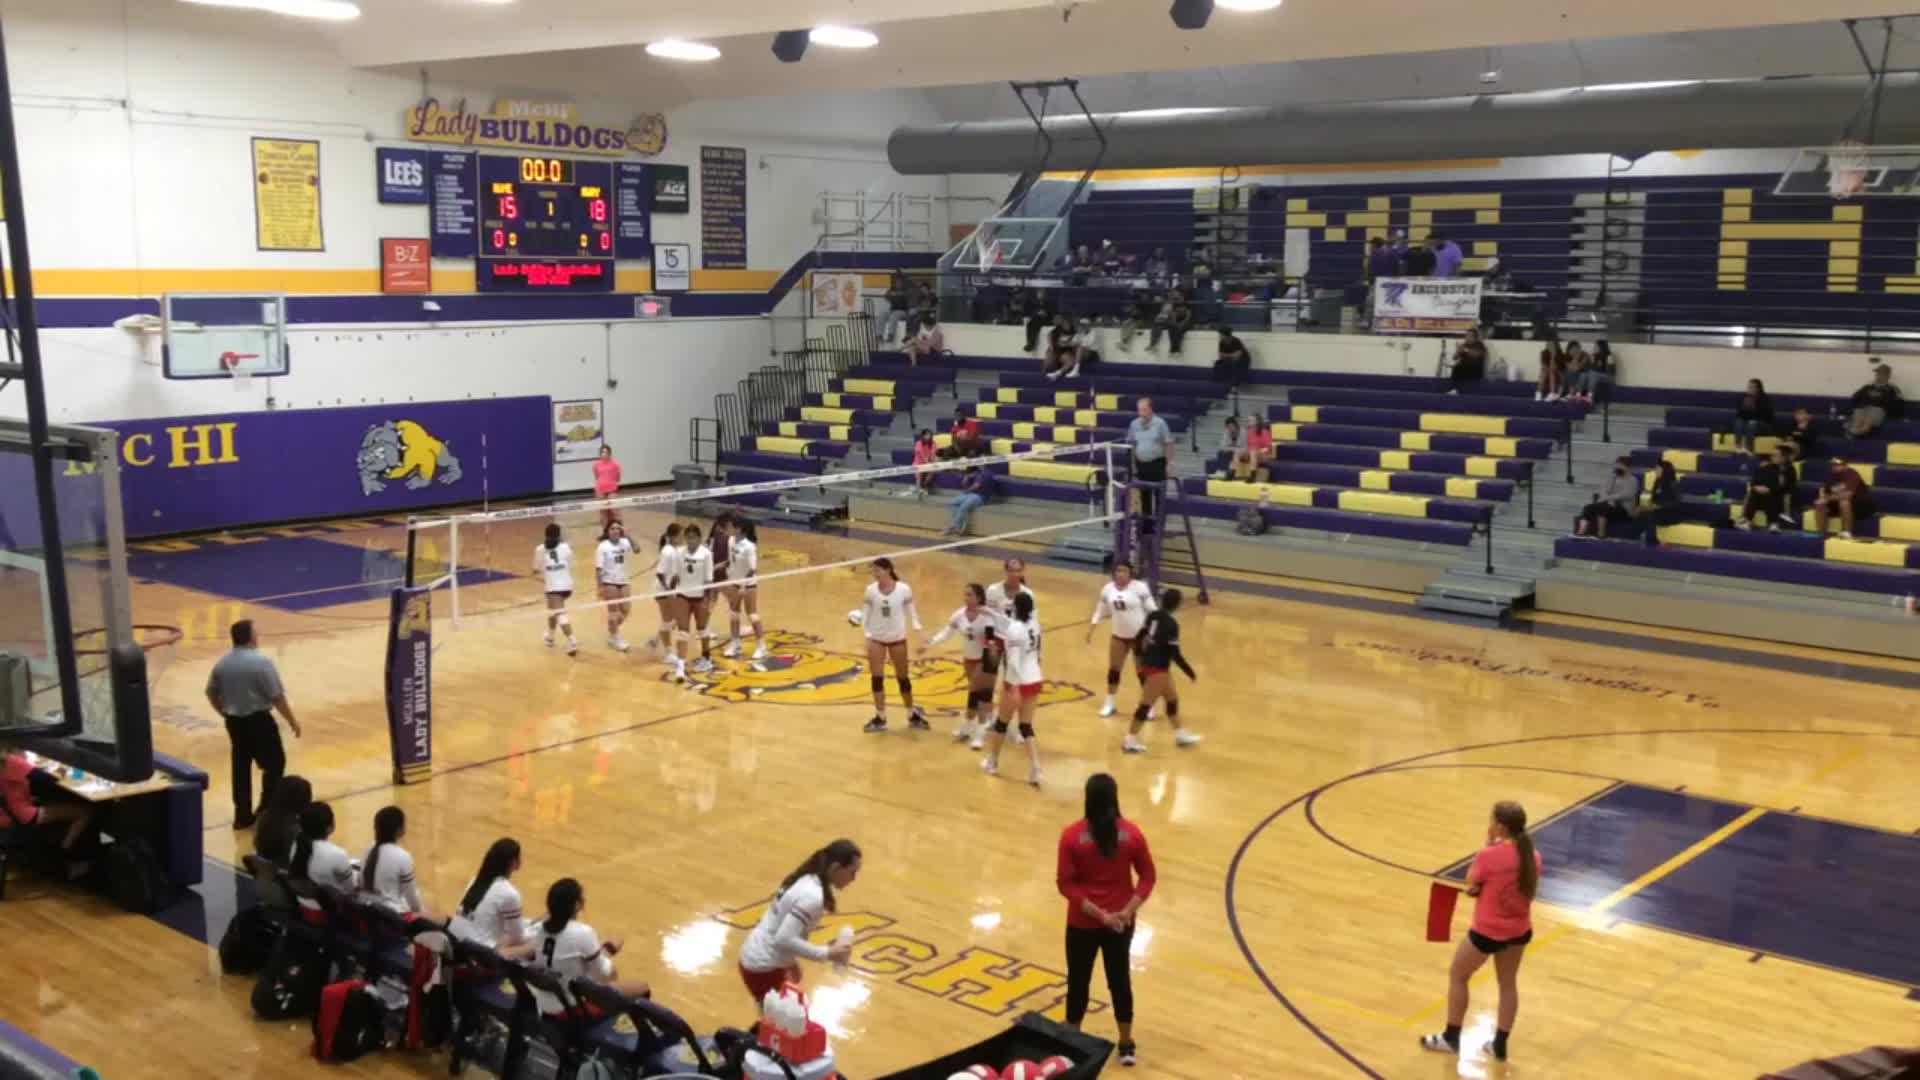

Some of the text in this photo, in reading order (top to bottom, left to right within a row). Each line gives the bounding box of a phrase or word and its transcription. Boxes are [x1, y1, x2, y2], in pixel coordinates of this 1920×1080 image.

[411, 98, 625, 149] Lady BULLDOGS
[500, 196, 517, 219] 15
[548, 201, 554, 217] 1
[590, 199, 606, 221] 18
[493, 229, 504, 249] 0
[599, 231, 610, 250] 0
[166, 422, 240, 468] HI
[414, 641, 428, 757] LADY BULLDOGS
